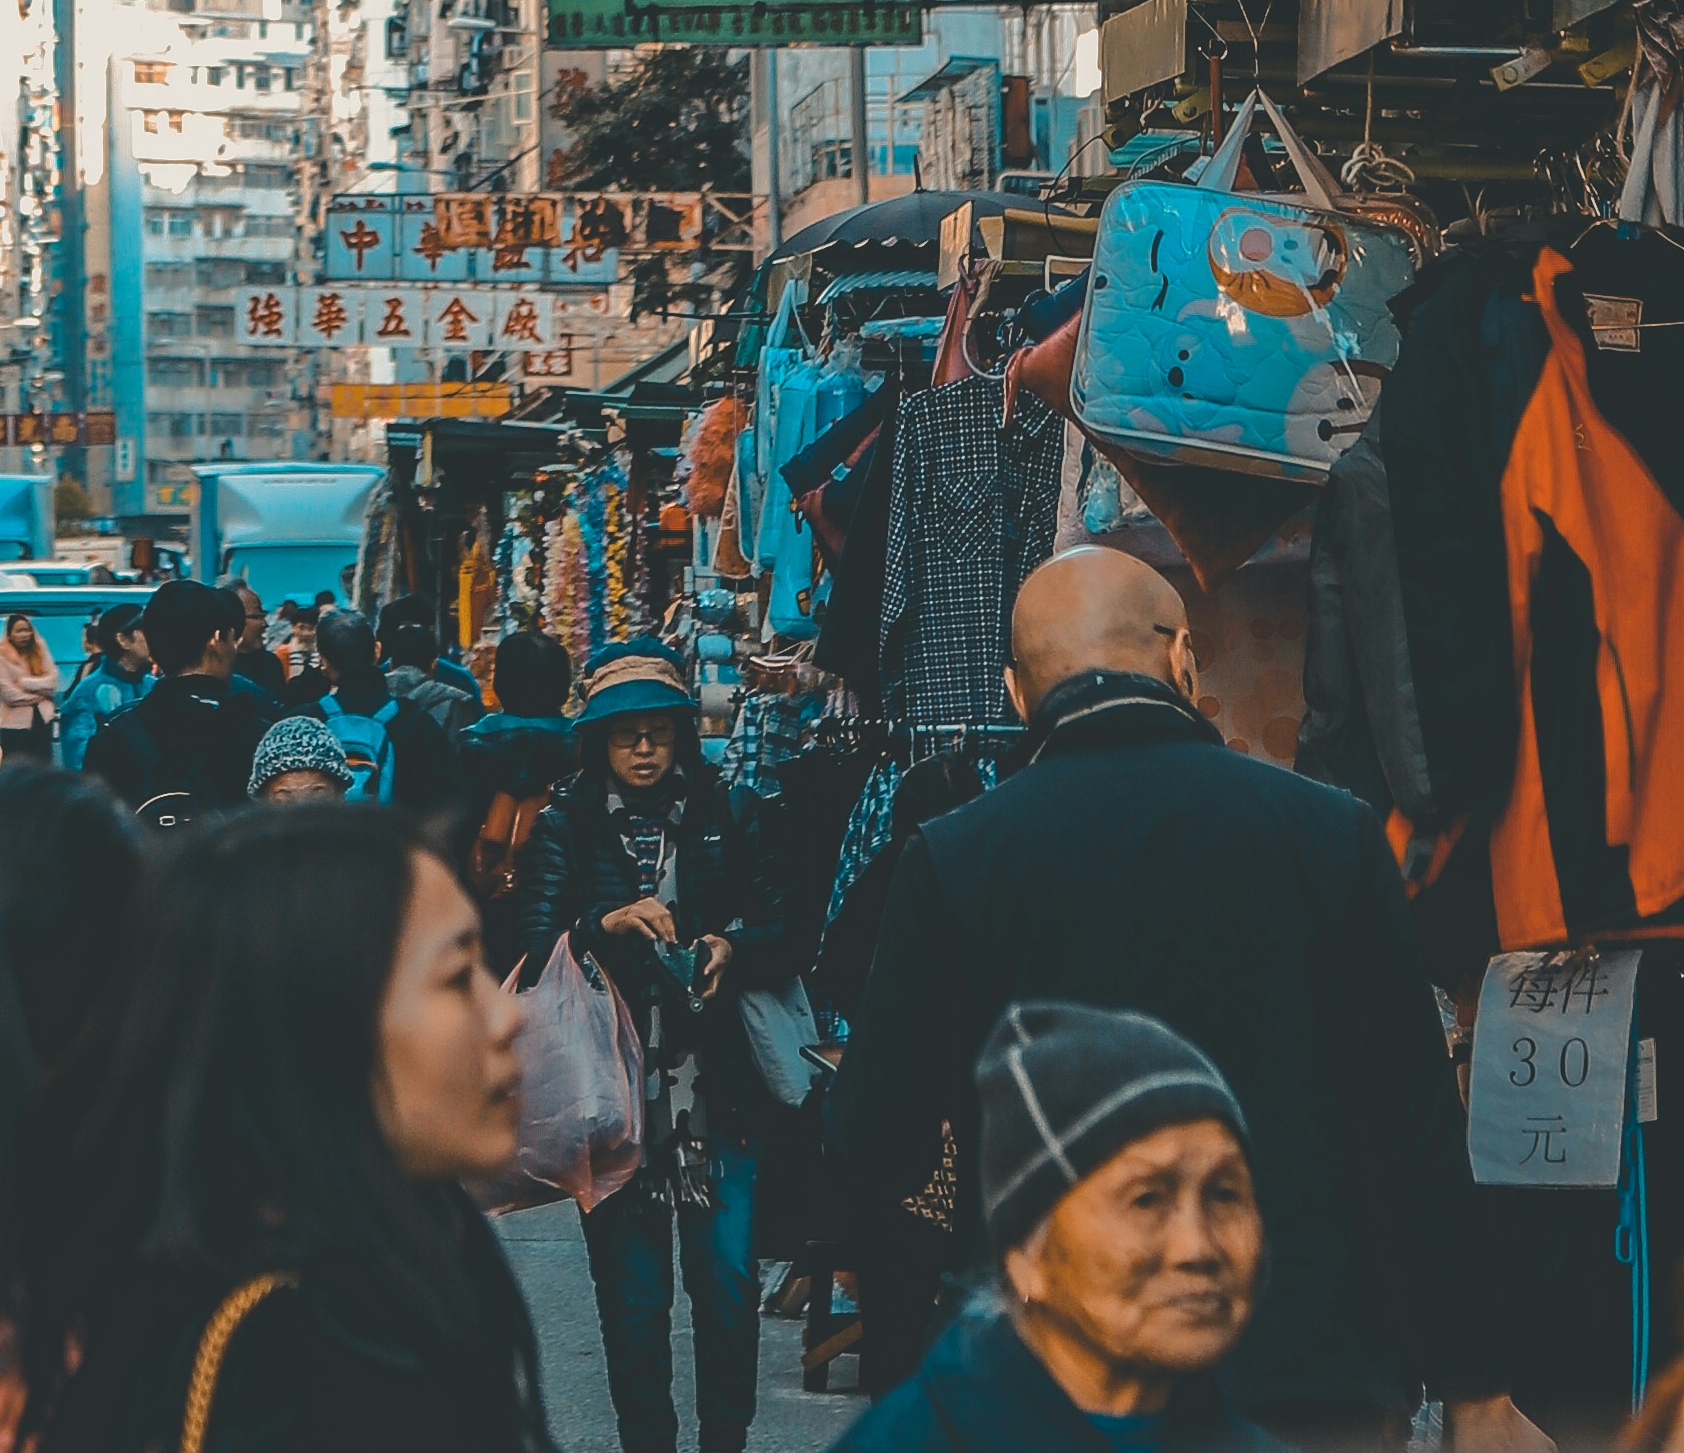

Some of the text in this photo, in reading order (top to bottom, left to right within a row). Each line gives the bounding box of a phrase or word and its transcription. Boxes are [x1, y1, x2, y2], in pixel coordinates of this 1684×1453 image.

[1509, 964, 1609, 1016] 每件
[1508, 1037, 1590, 1087] 30
[1519, 1114, 1568, 1166] 元
